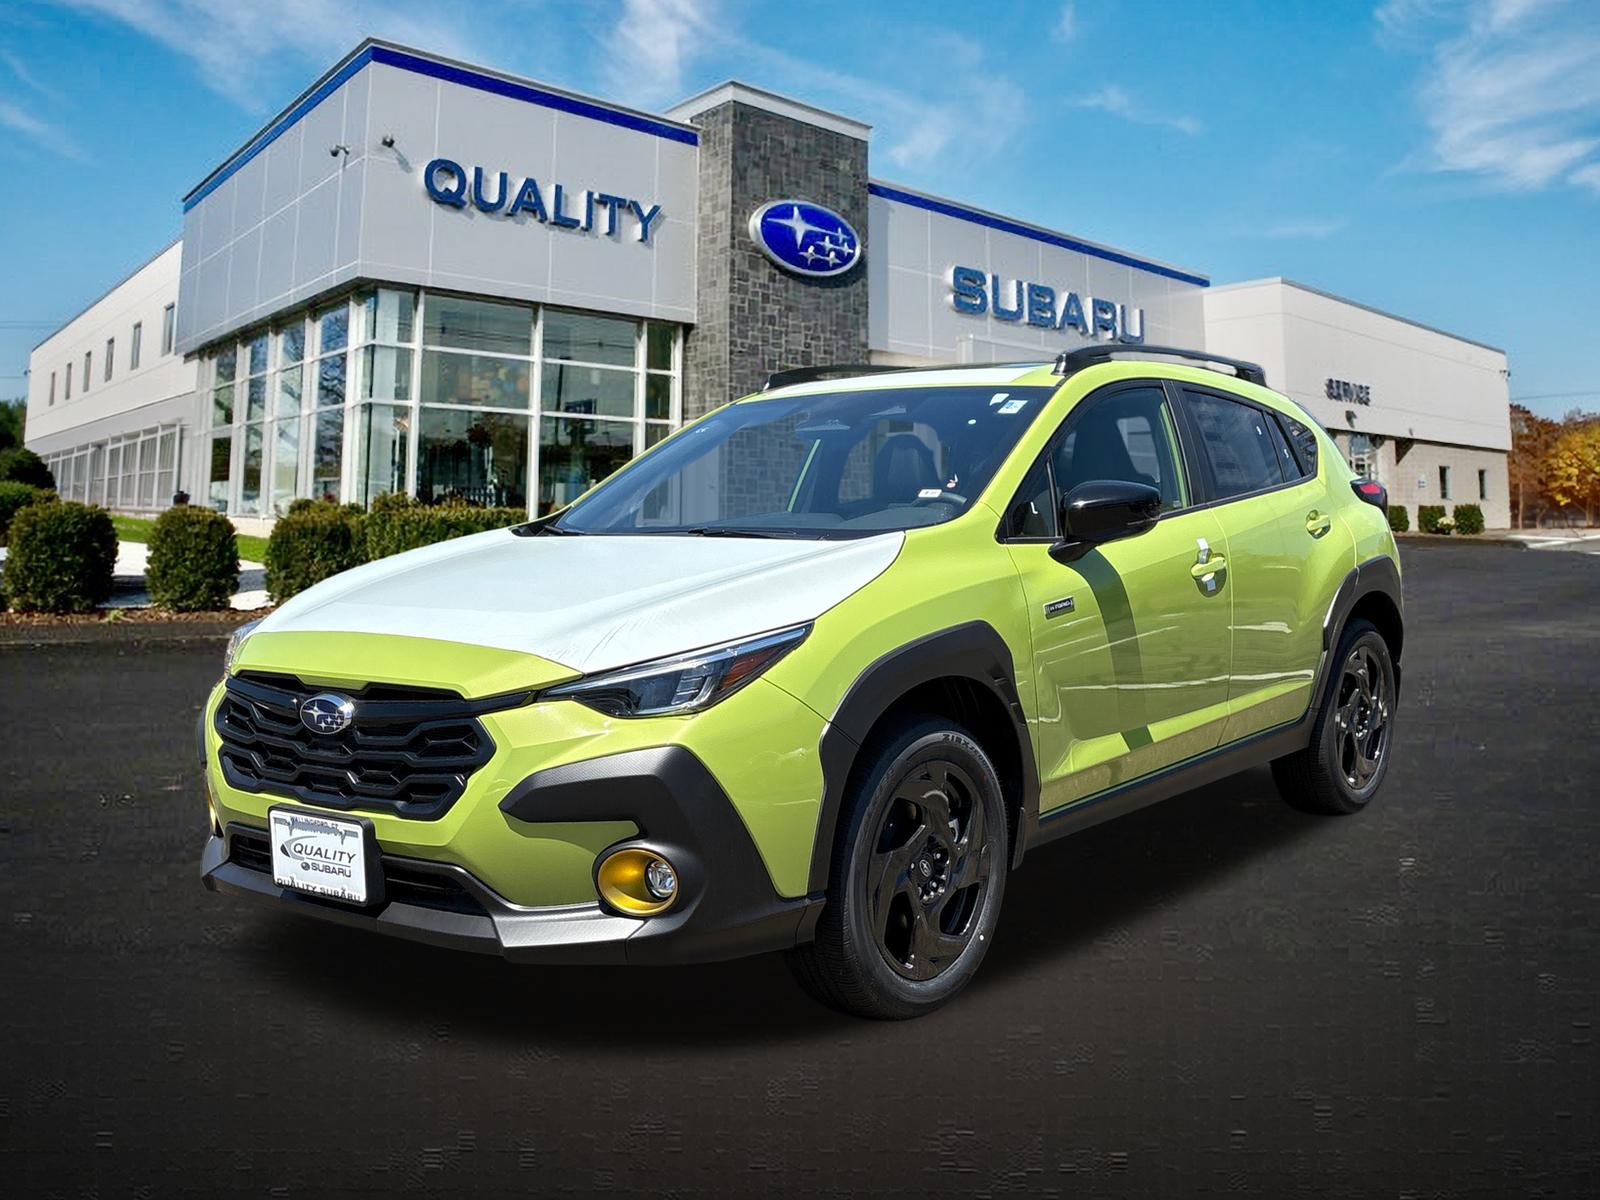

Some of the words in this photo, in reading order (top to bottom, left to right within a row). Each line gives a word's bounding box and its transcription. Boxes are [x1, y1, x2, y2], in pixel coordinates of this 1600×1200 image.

[423, 158, 662, 242] QUALITY
[952, 265, 1145, 345] SUBARU
[1325, 378, 1371, 406] SERVICE
[293, 842, 356, 864] QUALITY
[310, 862, 352, 878] SUBARU
